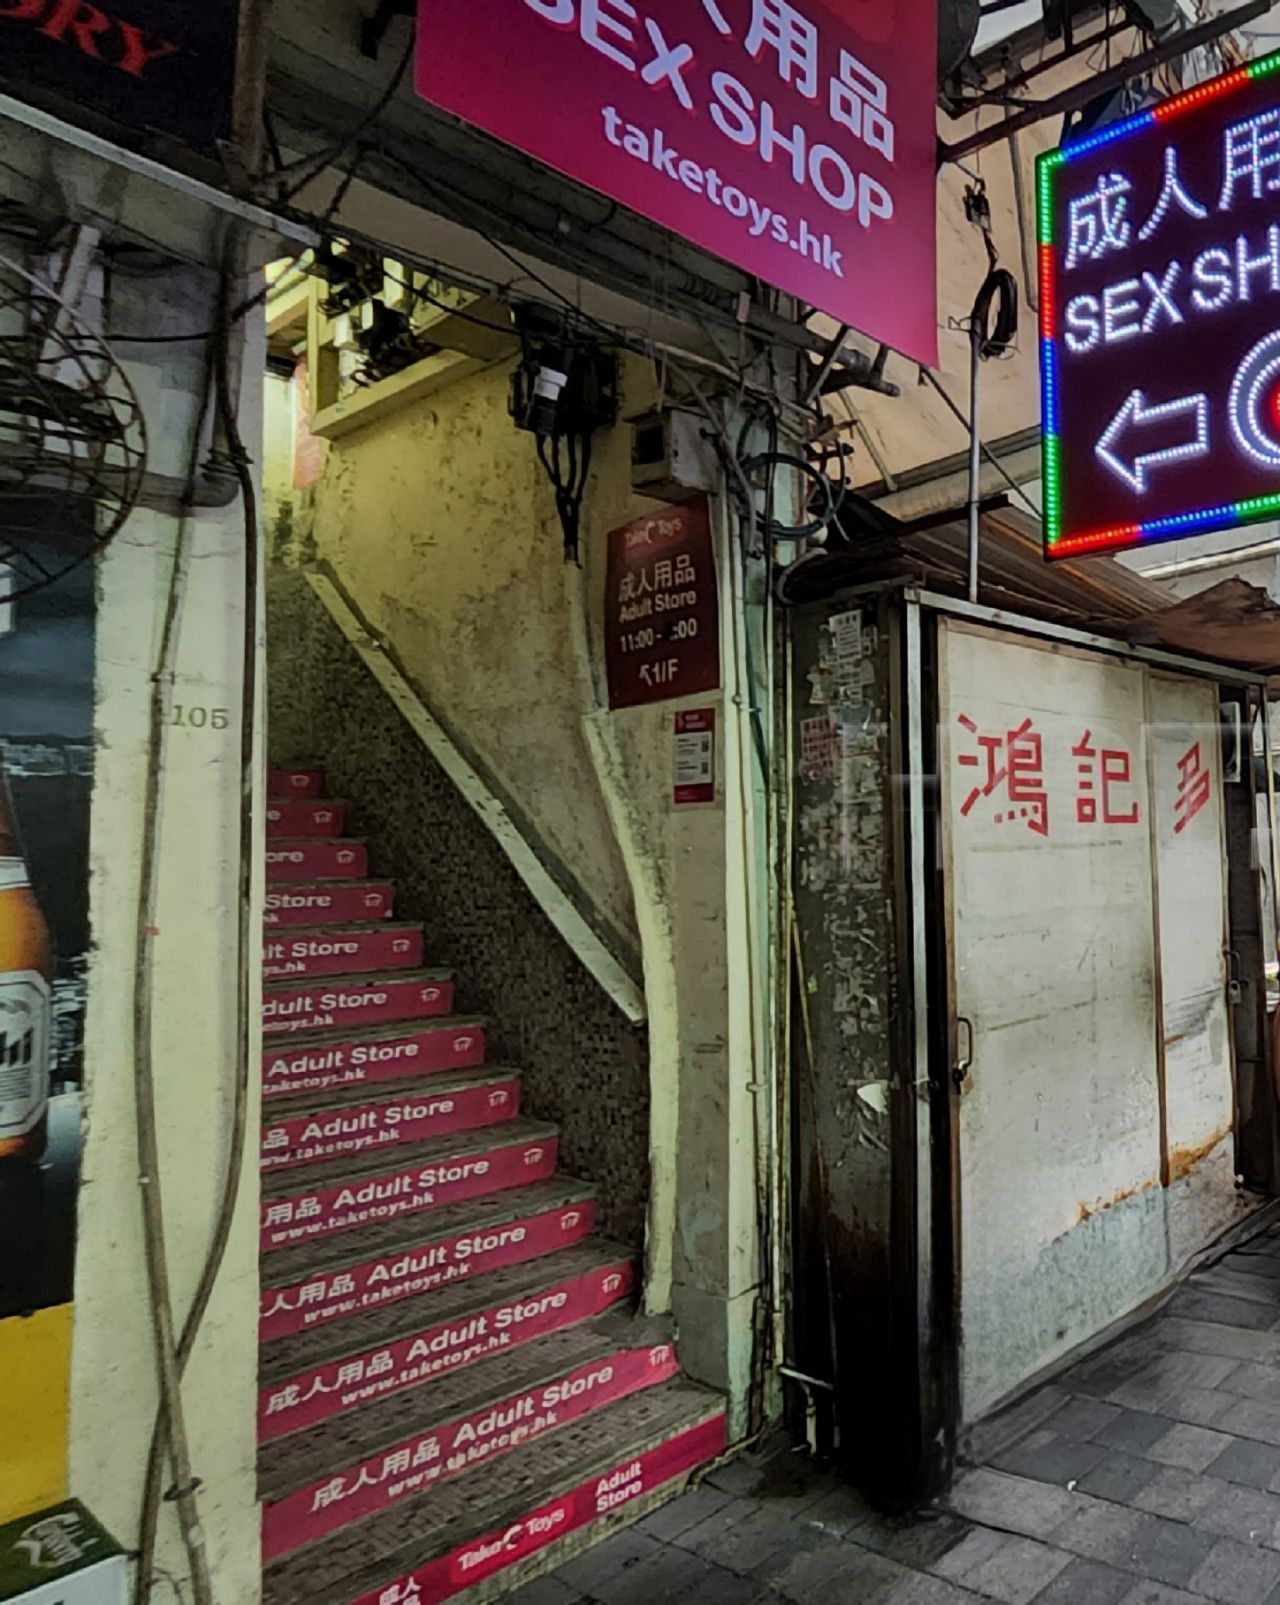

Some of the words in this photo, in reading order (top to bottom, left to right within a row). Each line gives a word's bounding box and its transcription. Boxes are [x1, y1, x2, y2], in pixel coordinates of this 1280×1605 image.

[709, 71, 895, 229] SHOP
[601, 104, 845, 280] taketoys.hk
[1064, 260, 1184, 354] SEX
[618, 553, 696, 604] 成人用品
[619, 599, 653, 625] Adult
[655, 590, 697, 613] Store
[621, 627, 654, 654] 11:00
[170, 704, 230, 730] 105
[292, 941, 359, 958] Store
[261, 996, 314, 1017] dult
[320, 991, 388, 1011] Store
[268, 1053, 345, 1079] Adult
[350, 1042, 420, 1065] Store
[300, 1111, 377, 1142] Adult
[383, 1100, 454, 1125] Store
[332, 1175, 412, 1209] Adult
[418, 1160, 490, 1189] Store
[263, 1196, 323, 1228] 用品
[271, 1192, 435, 1243] www.taketoys.hk
[366, 1245, 448, 1286] Adult
[454, 1226, 527, 1260] Store
[303, 1260, 473, 1324] www.taketoys.hk
[405, 1317, 489, 1362] Adult
[494, 1291, 568, 1330] Store
[264, 1350, 394, 1417] 成人用品
[340, 1331, 511, 1406] www.taketoys.hk
[452, 1395, 534, 1448] Adult
[541, 1363, 614, 1409] Store
[309, 1436, 442, 1512] 成人用品
[595, 1462, 642, 1496] Adult
[597, 1480, 643, 1512] Store
[526, 1508, 565, 1535] Toys
